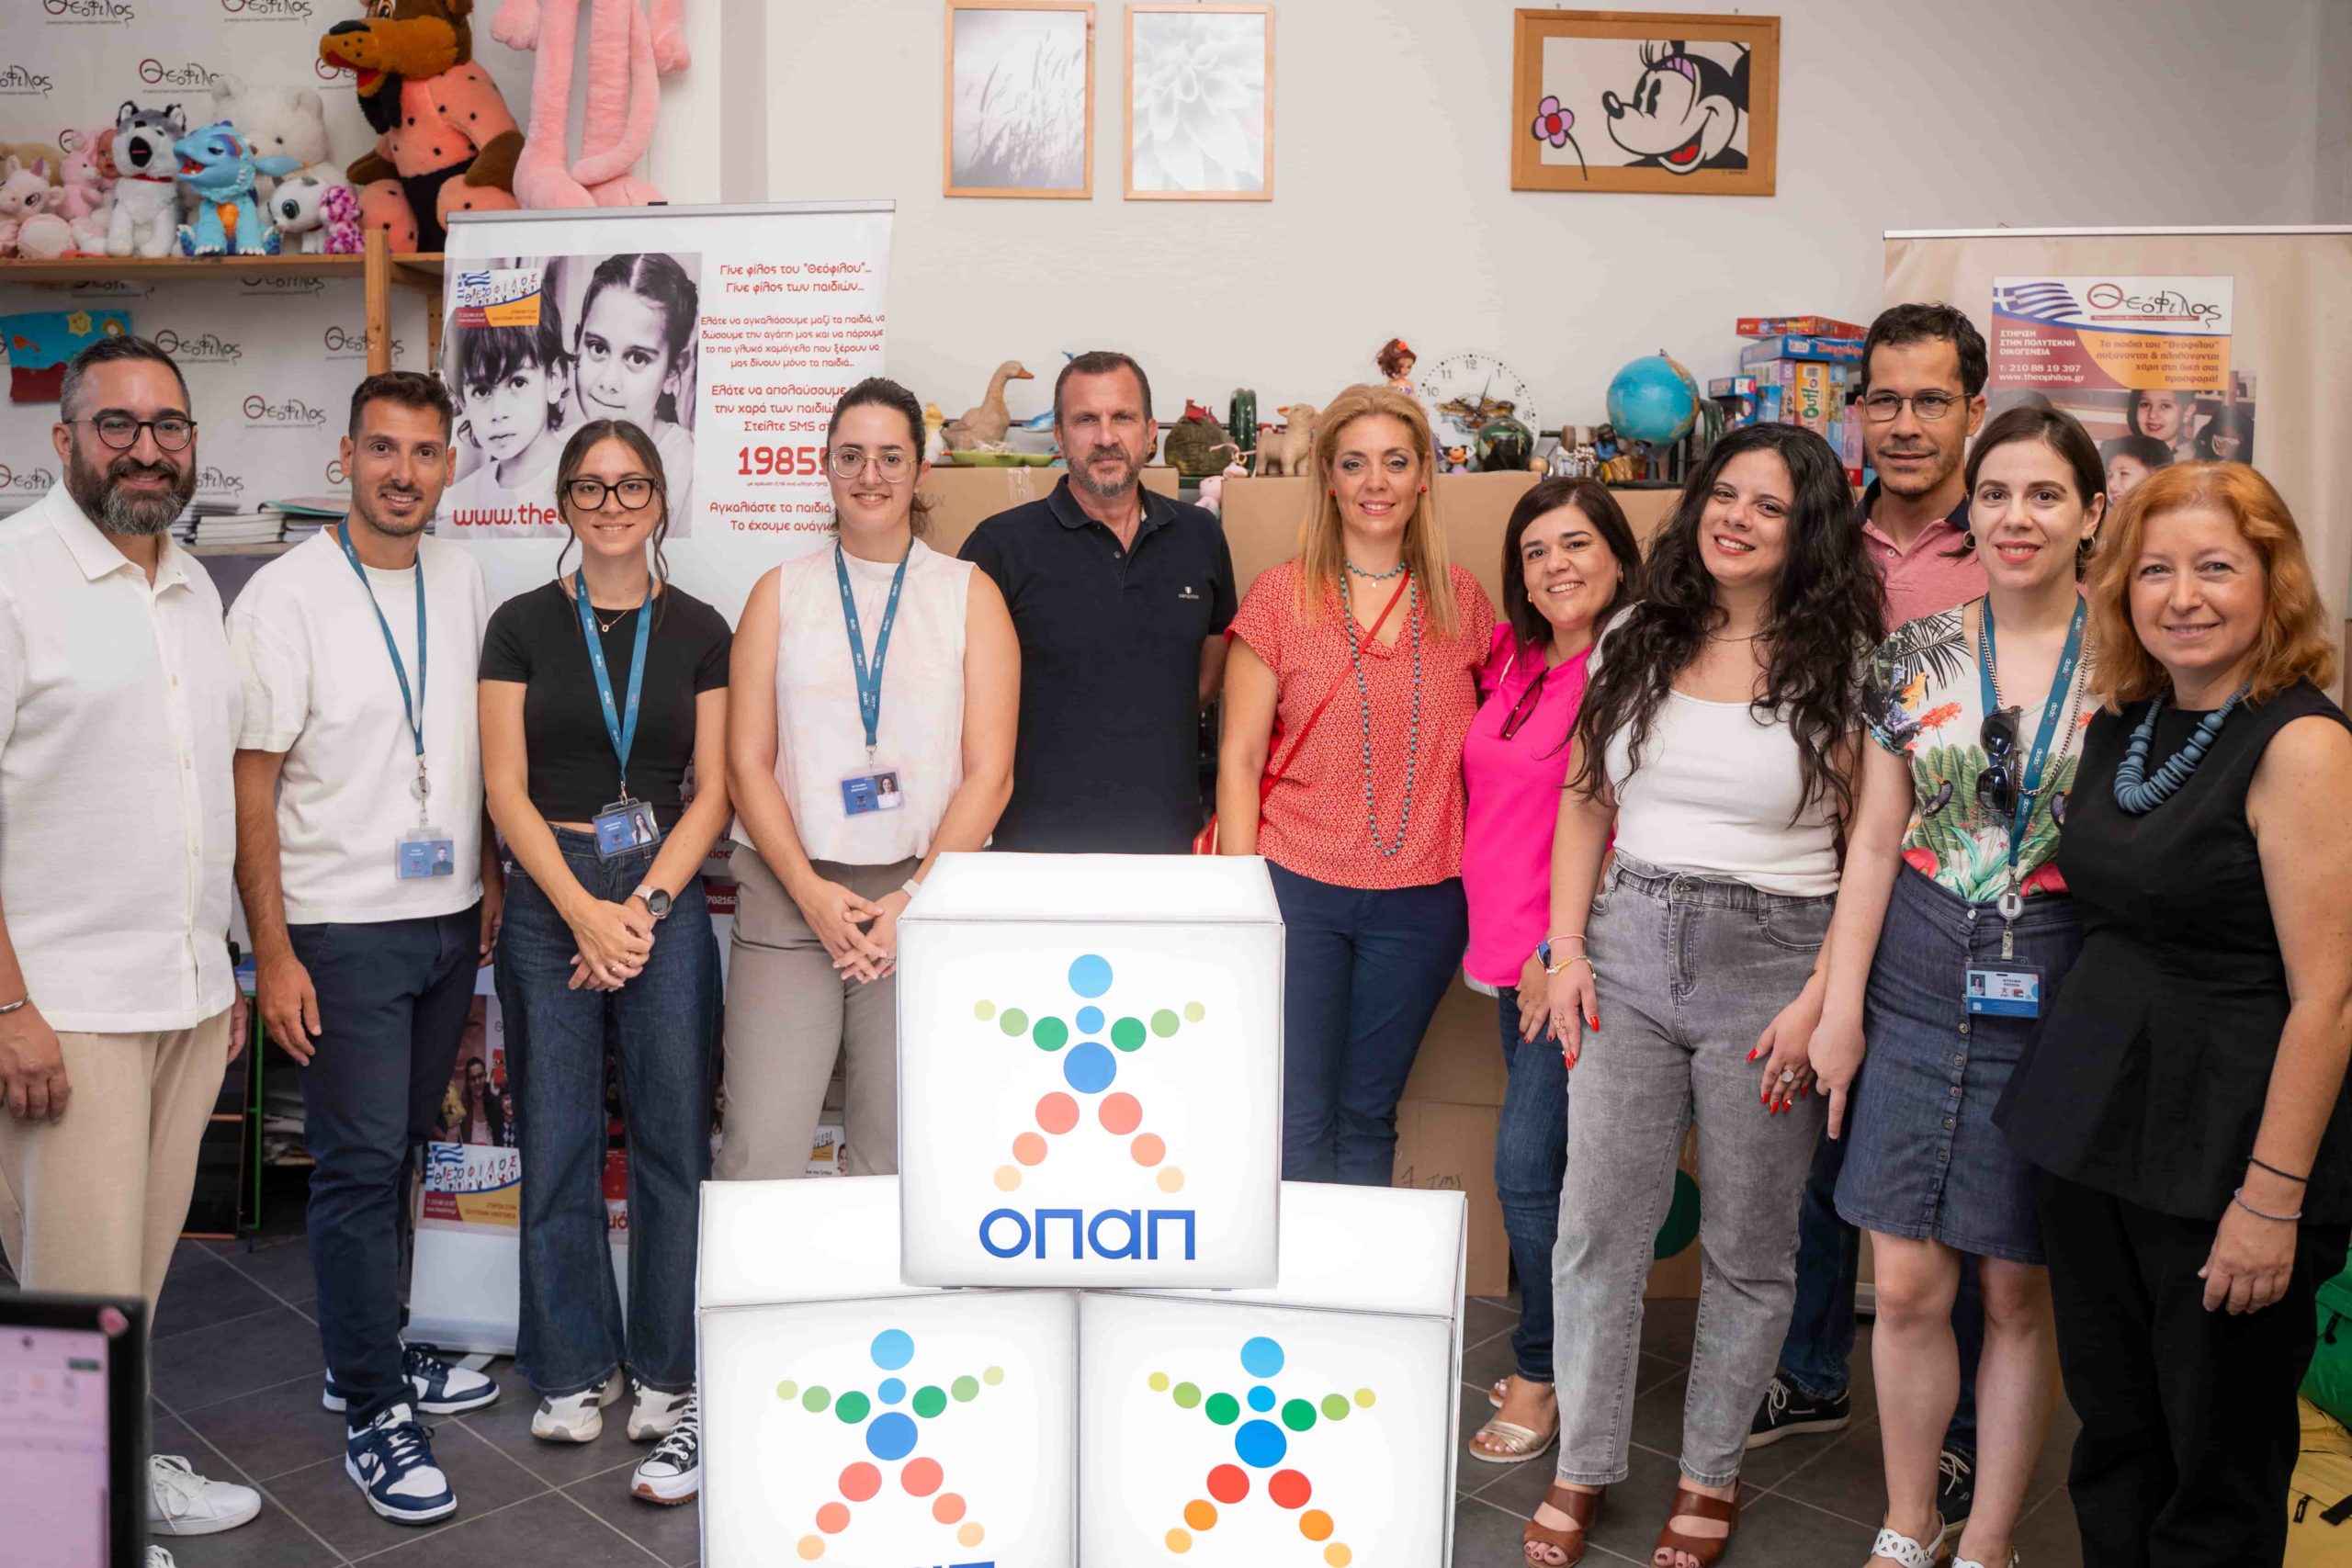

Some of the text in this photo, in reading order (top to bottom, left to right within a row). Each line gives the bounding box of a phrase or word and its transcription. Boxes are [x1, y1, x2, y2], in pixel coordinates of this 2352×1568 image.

[719, 264, 743, 276] Γίνε
[746, 264, 777, 277] φίλος
[780, 265, 800, 275] του
[726, 281, 750, 293] Γίνε
[752, 281, 783, 295] φίλος
[786, 283, 809, 292] των
[2086, 283, 2222, 330] Θεόφιλος
[700, 316, 727, 326] Ελάτε
[729, 318, 741, 326] να
[743, 315, 808, 327] αγκαλιάσουμε
[810, 315, 831, 327] μαζί
[876, 314, 886, 322] να
[701, 329, 884, 342] δώσουμε την αγάπη μας και να πάρουμε
[706, 343, 879, 356] το πιο γλυκό χαμόγελο που ξέρουν να
[2024, 339, 2075, 347] ΠΟΛΥΤΕΚΝΗ
[730, 359, 748, 370] μας
[750, 357, 781, 368] δίνουν
[783, 358, 808, 370] μόνο
[808, 359, 820, 368] τα
[2008, 364, 2030, 372] 210
[2030, 364, 2044, 372] 88
[2046, 365, 2061, 373] 19
[2061, 365, 2082, 373] 397
[1441, 369, 1453, 379] 11
[711, 384, 846, 398] Ελάτε να απολαύσουμε
[1426, 386, 1440, 397] 10
[243, 395, 327, 431] Θεόφιλος
[715, 401, 836, 415] την χαρά των παιδιώ
[743, 420, 786, 433] Στείλτε
[788, 421, 816, 432] SMS
[709, 502, 831, 515] Αγκαλιάστε τα παιδιά
[730, 520, 745, 532] Το
[748, 519, 791, 534] έχουμε
